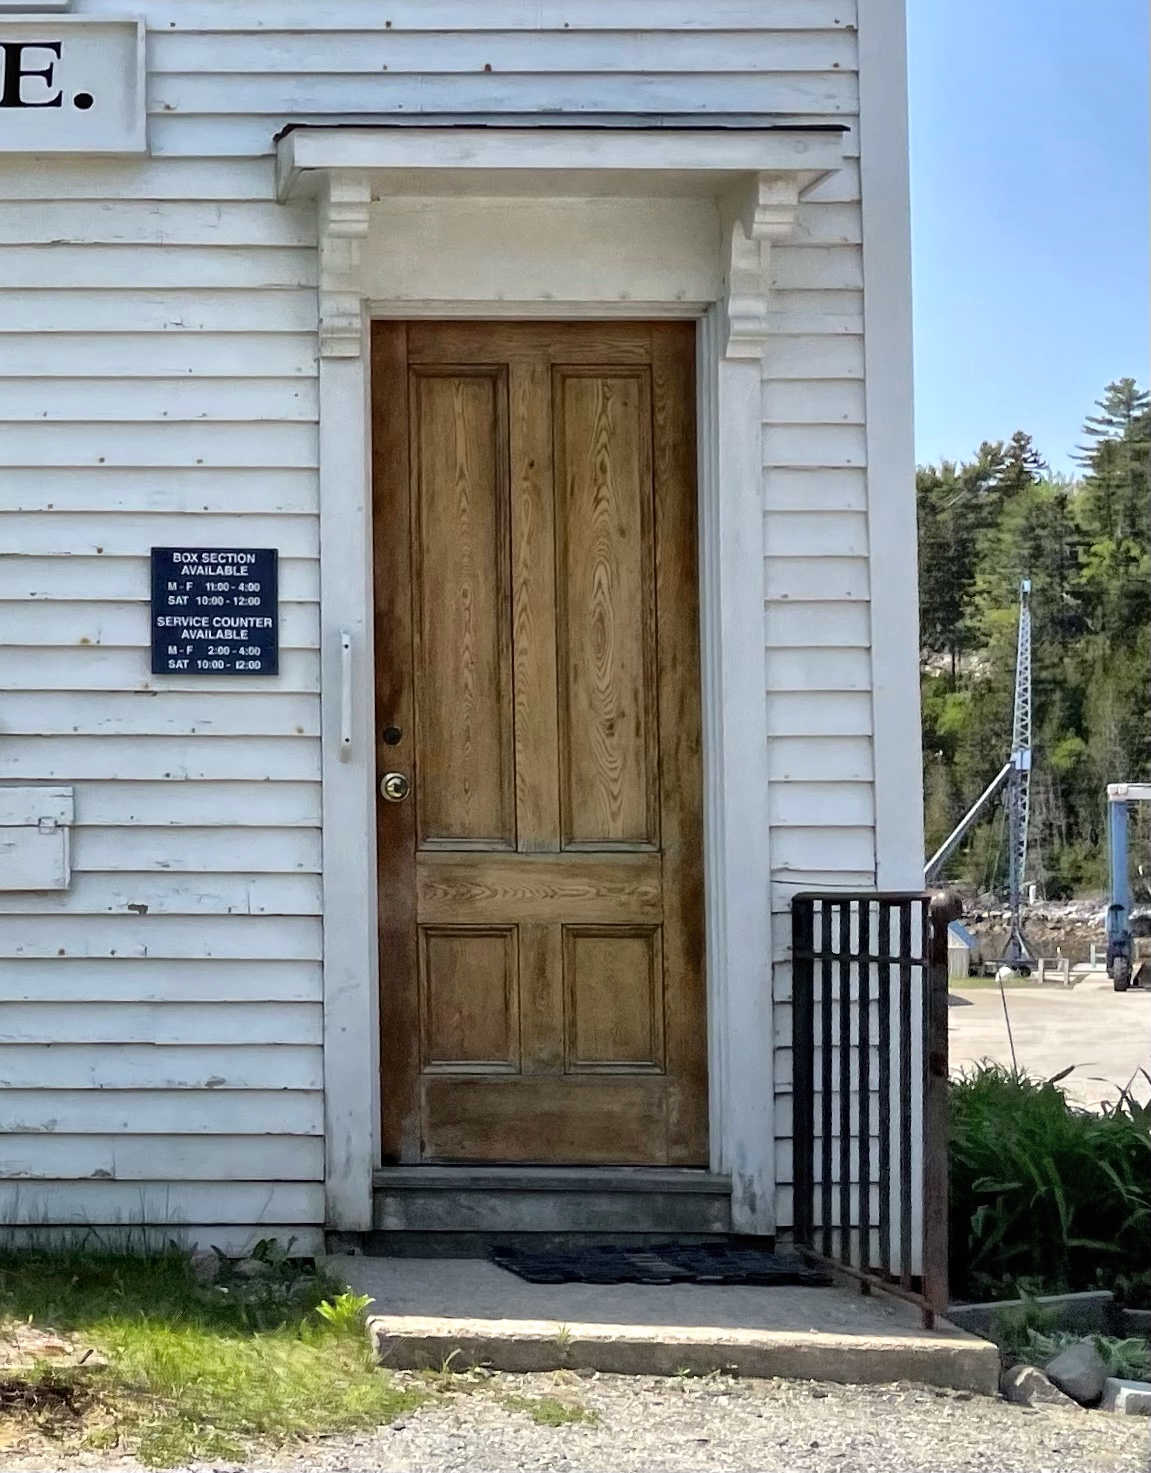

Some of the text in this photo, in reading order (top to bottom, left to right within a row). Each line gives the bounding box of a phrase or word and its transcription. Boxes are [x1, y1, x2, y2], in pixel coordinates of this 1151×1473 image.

[173, 552, 256, 564] BOX SECTION
[181, 565, 249, 576] AVAILABLE
[168, 596, 189, 606] SAT
[196, 596, 224, 606] 10:00
[233, 596, 261, 606] 12:00
[156, 616, 273, 628] SERVICE COUNTER
[181, 629, 249, 640] AVAILABLE
[168, 659, 189, 669] SAT
[196, 660, 224, 669] 10:00
[235, 660, 261, 670] 12:00
